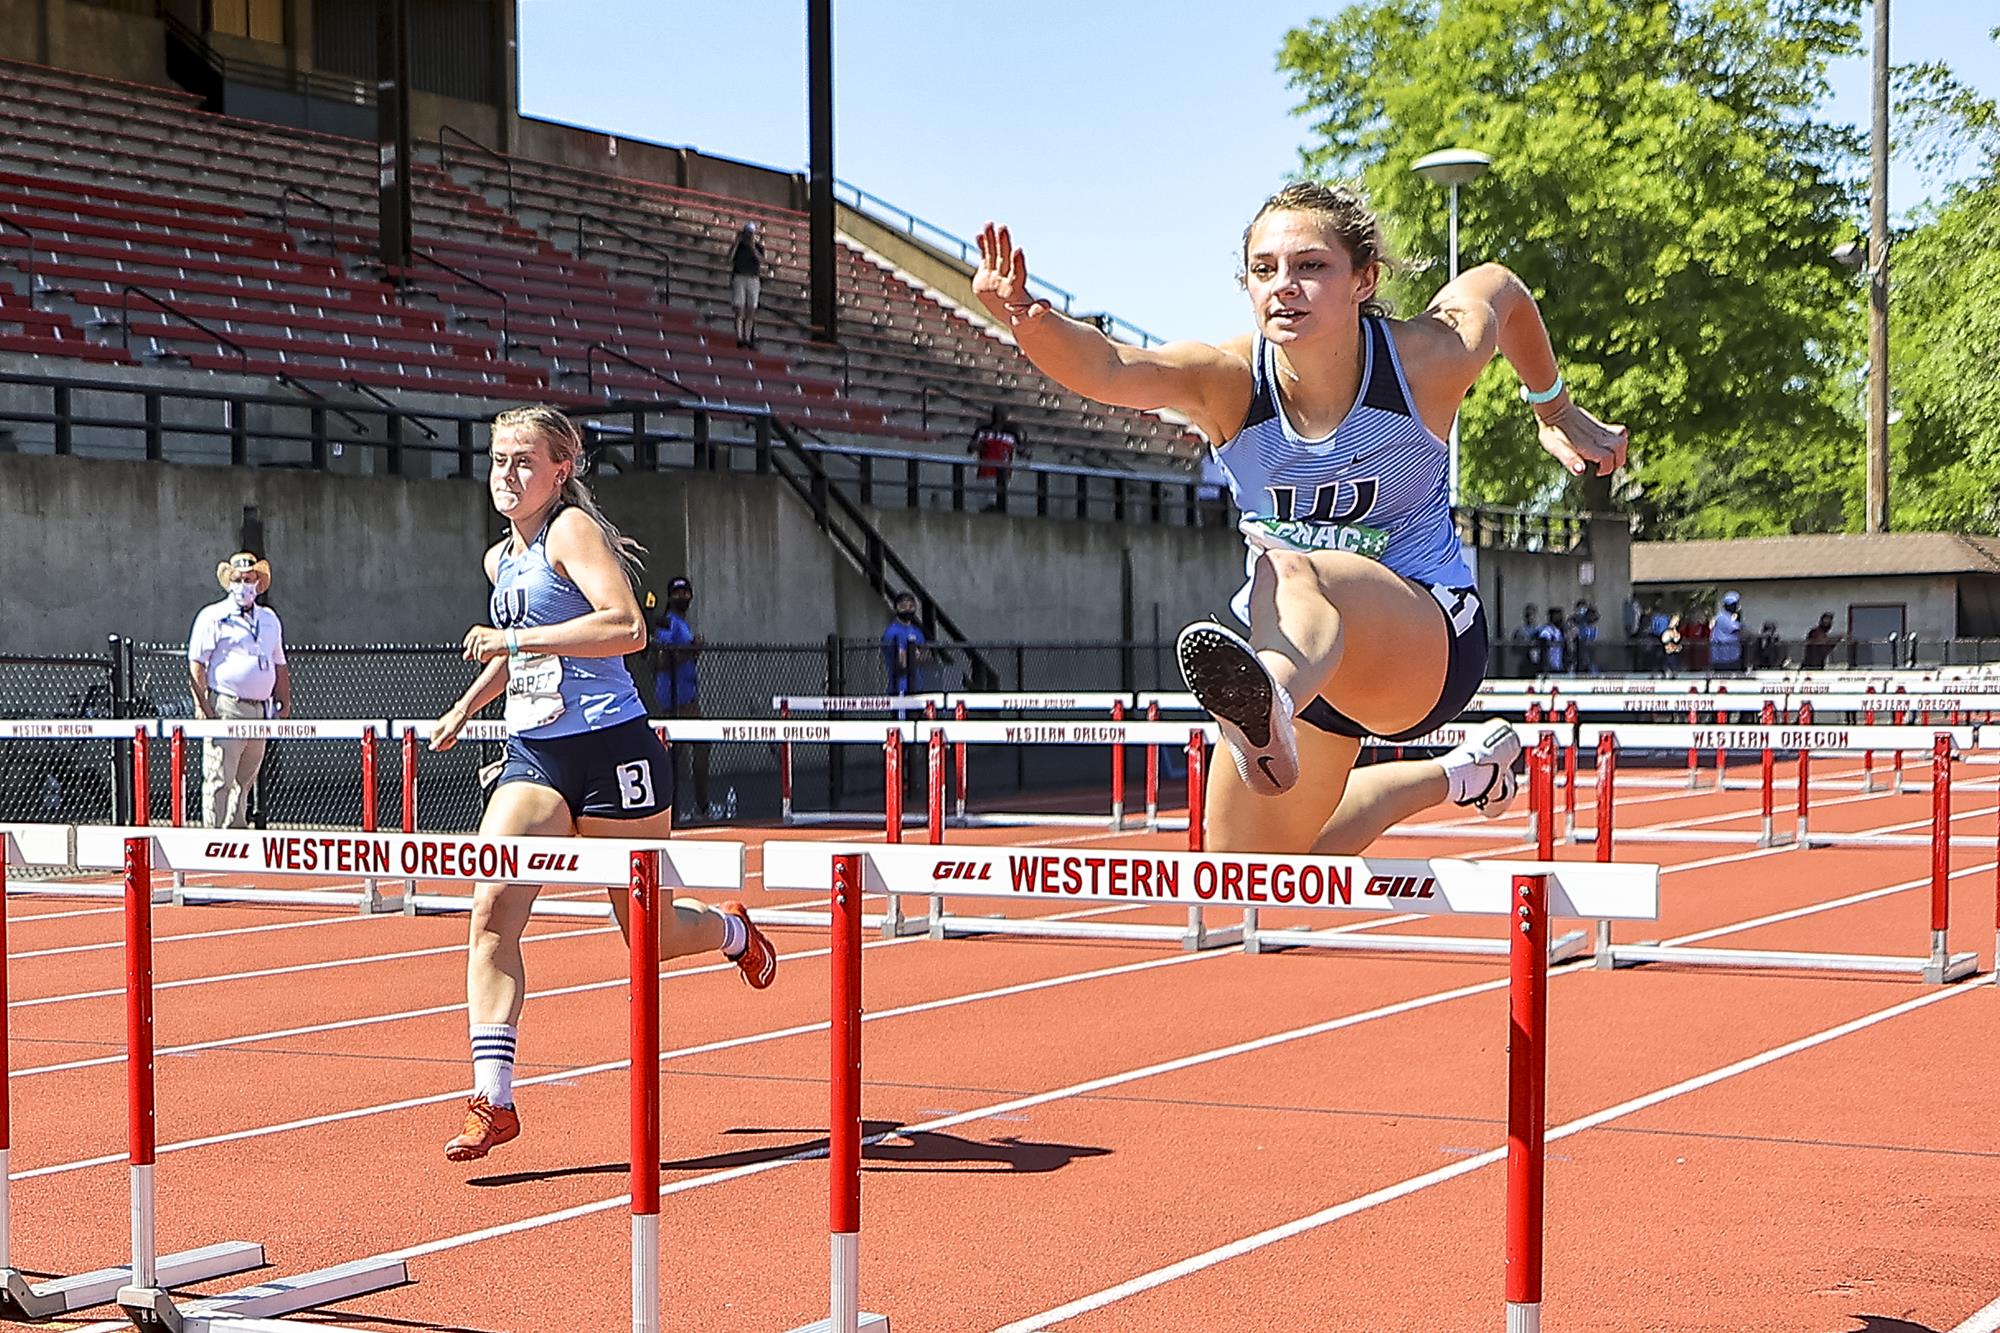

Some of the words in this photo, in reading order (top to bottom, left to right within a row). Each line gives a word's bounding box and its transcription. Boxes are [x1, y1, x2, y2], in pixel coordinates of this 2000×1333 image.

[1861, 700, 1911, 711] WESTERN
[1917, 699, 1962, 711] OREGON
[11, 724, 53, 736] WESTERN
[57, 724, 94, 736] OREGON
[226, 724, 275, 737] WESTERN
[277, 725, 317, 737] OREGON
[465, 725, 508, 739] WESTER
[722, 726, 777, 740] WESTERN
[783, 727, 831, 741] OREGON
[1005, 727, 1066, 743] WESTERN
[1073, 727, 1126, 743] OREGON
[1692, 731, 1770, 749] WESTERN
[1781, 731, 1850, 749] OREGON
[624, 764, 648, 805] 3
[205, 842, 250, 859] GILL
[262, 837, 391, 873] WESTERN
[400, 840, 519, 878] OREGON
[527, 853, 580, 871] GILL
[932, 861, 993, 881] GILL
[1009, 855, 1180, 898] WESTERN
[1193, 861, 1353, 906] OREGON
[1365, 875, 1437, 899] GILL
